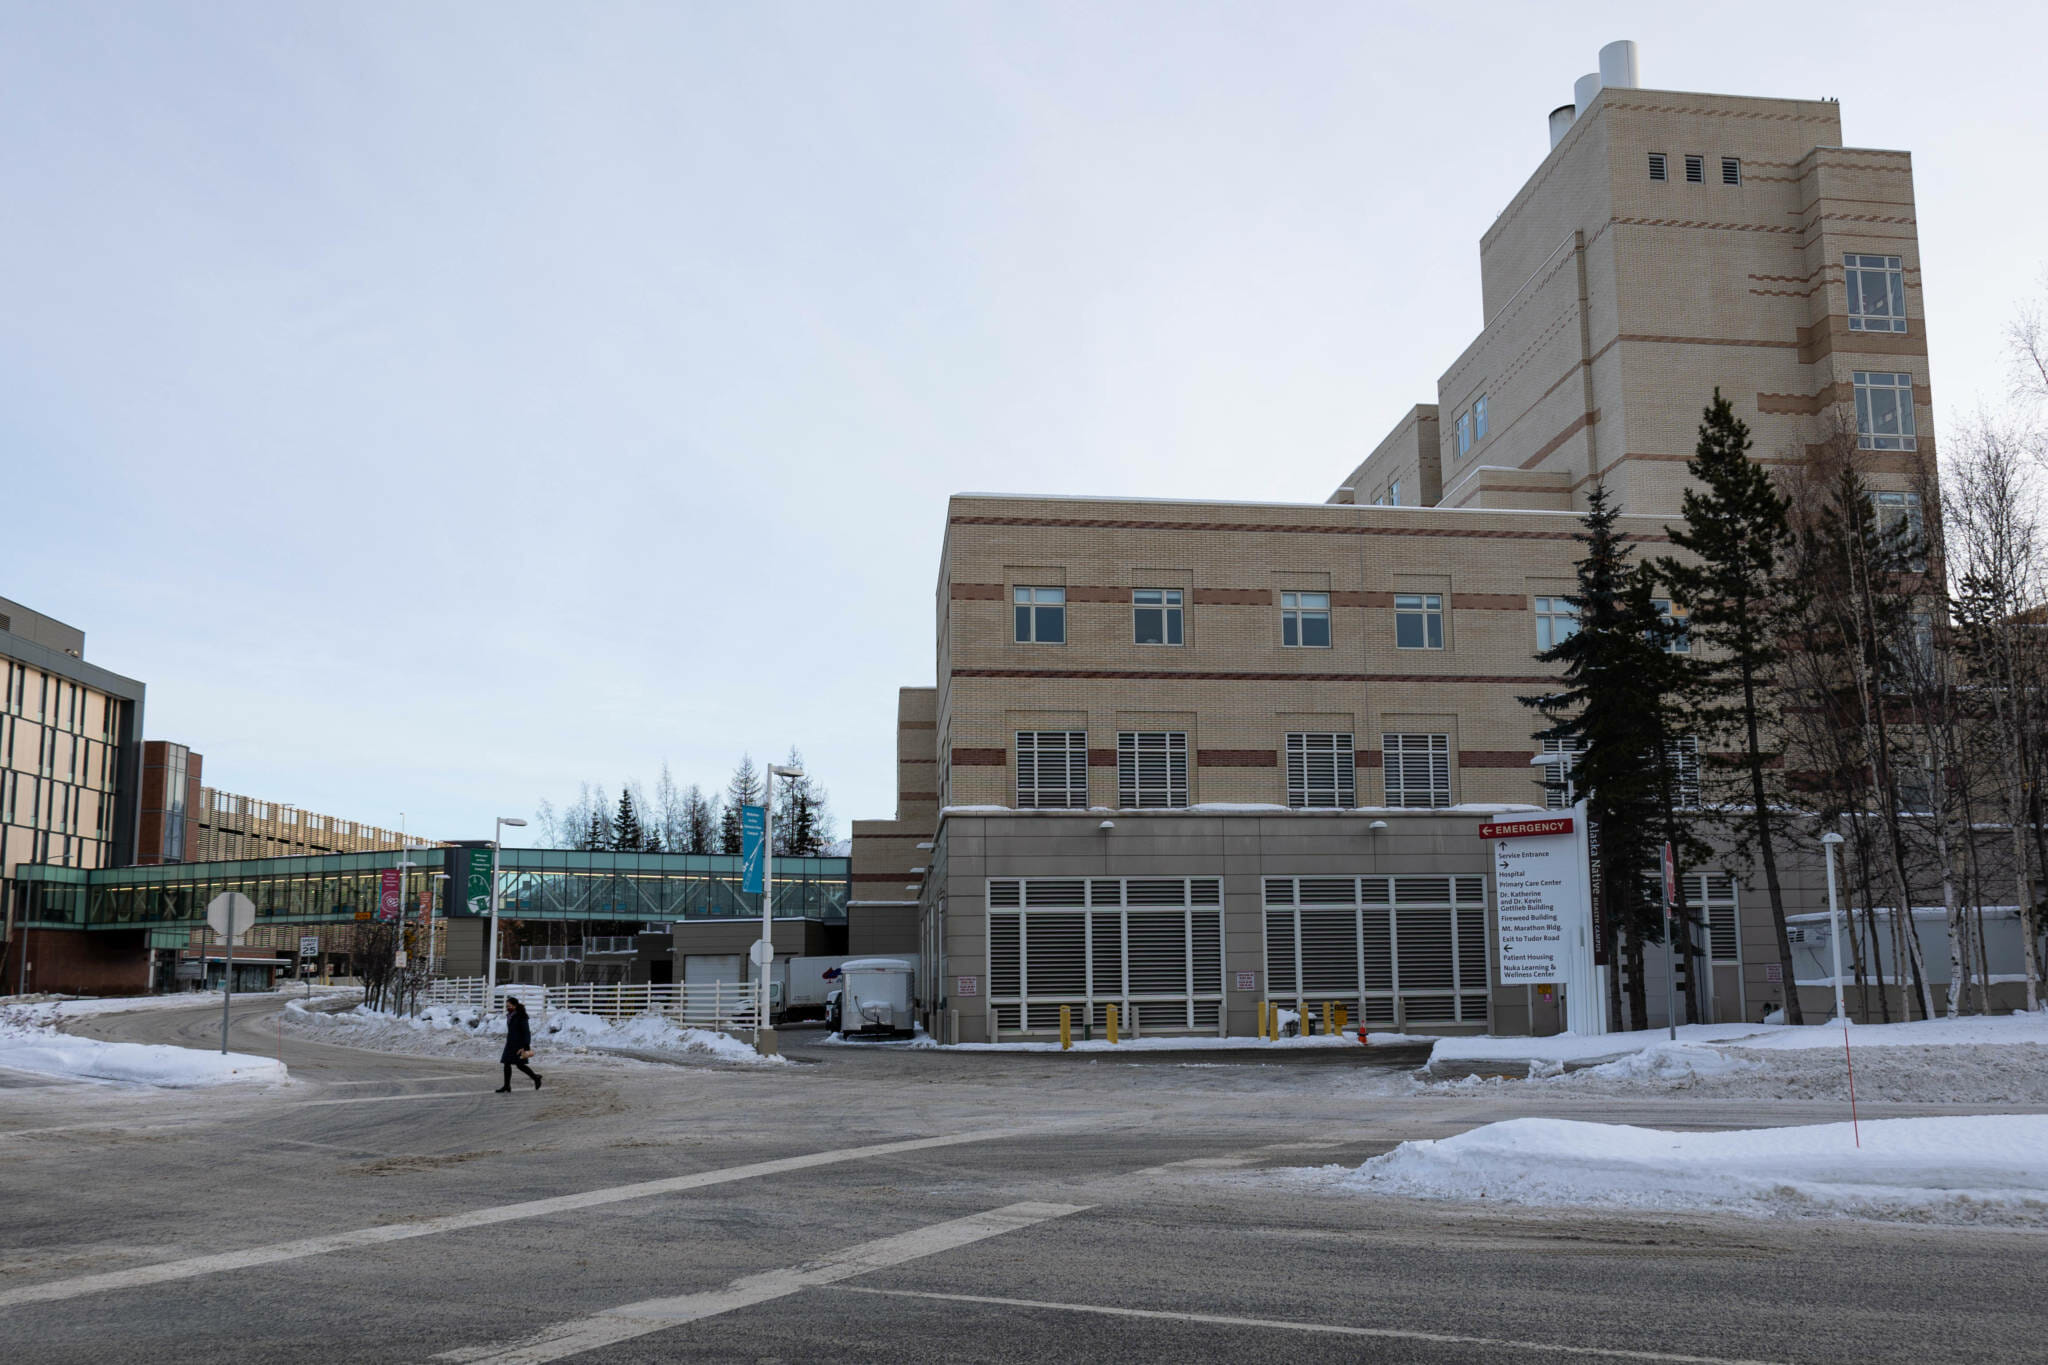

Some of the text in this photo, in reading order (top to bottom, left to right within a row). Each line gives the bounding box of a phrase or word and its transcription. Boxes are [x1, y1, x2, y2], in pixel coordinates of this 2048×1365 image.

[1495, 821, 1565, 835] EMERGENCY
[1588, 820, 1601, 857] Alaska
[1591, 858, 1602, 895] Native
[1499, 881, 1524, 889] Primary
[1527, 904, 1554, 912] Building
[1530, 914, 1558, 922] Building
[1546, 924, 1563, 932] Bldg.
[1502, 935, 1514, 943] Exit
[302, 946, 316, 955] 25
[1527, 953, 1554, 962] Housing
[1521, 964, 1550, 972] Learning
